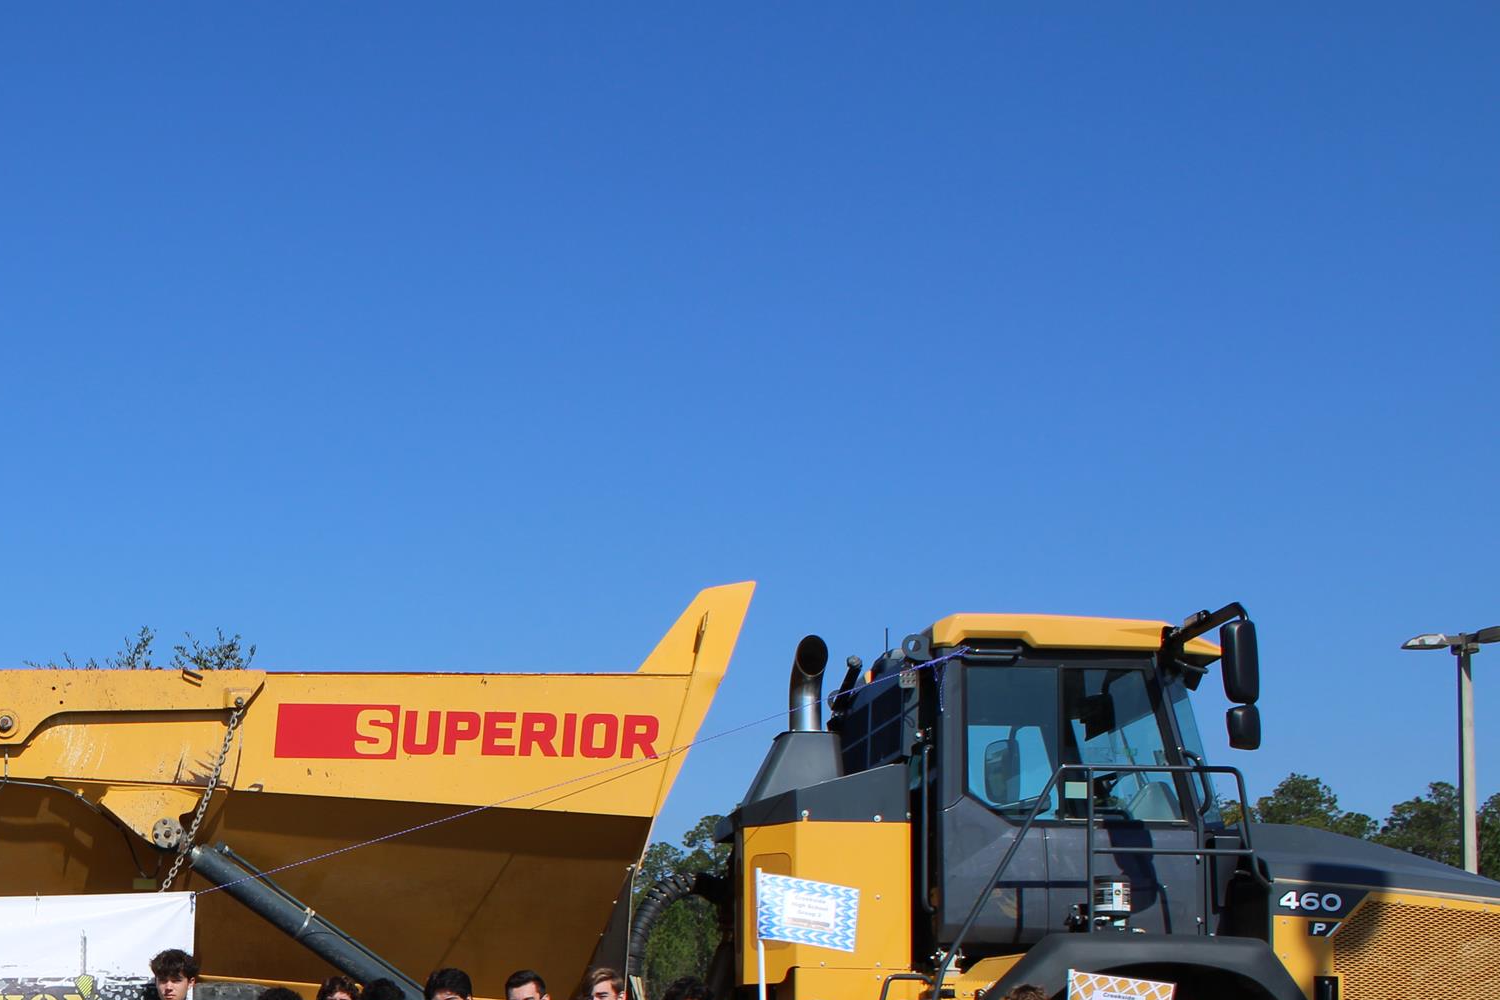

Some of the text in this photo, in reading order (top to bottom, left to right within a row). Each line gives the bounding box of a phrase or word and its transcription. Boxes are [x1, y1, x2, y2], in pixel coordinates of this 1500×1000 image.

[354, 708, 660, 759] SUPERIOR
[1279, 891, 1342, 912] 460
[1312, 923, 1327, 935] P
[1102, 992, 1136, 1000] Creekside
